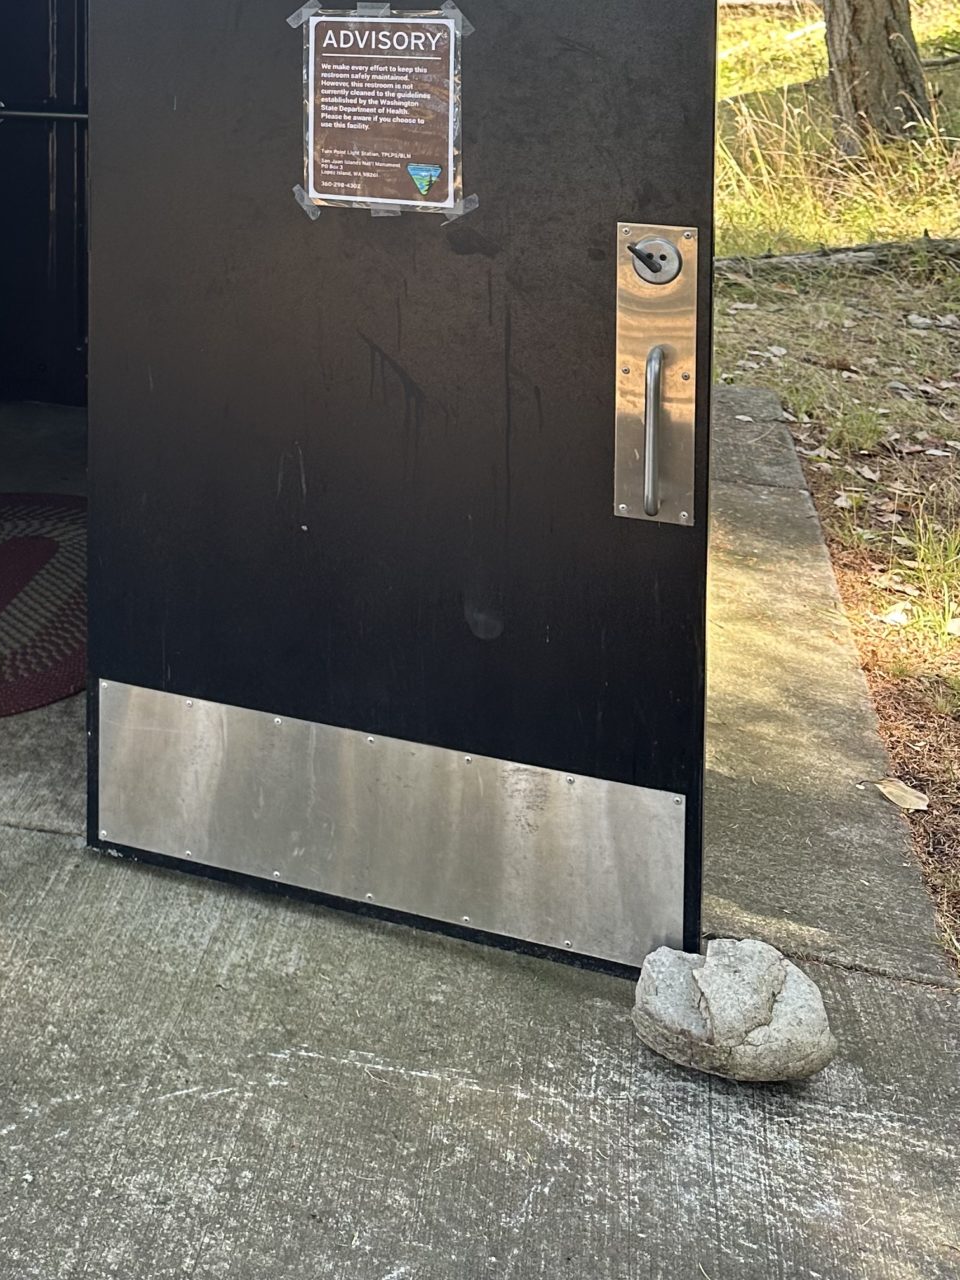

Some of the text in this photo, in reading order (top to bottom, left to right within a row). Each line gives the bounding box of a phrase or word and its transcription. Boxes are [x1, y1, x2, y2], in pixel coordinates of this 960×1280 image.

[322, 29, 442, 51] ADVISORY
[370, 64, 388, 72] effort
[397, 65, 414, 74] keep
[351, 72, 371, 81] safely
[321, 80, 350, 88] However,
[396, 91, 431, 99] guidelines
[320, 96, 358, 104] established
[358, 97, 367, 106] by
[379, 99, 419, 108] Washington
[339, 105, 377, 113] Department
[386, 107, 410, 115] Health.
[379, 116, 391, 124] you
[392, 116, 417, 124] choose
[417, 117, 425, 125] to
[333, 121, 346, 129] this
[346, 121, 370, 131] facility.
